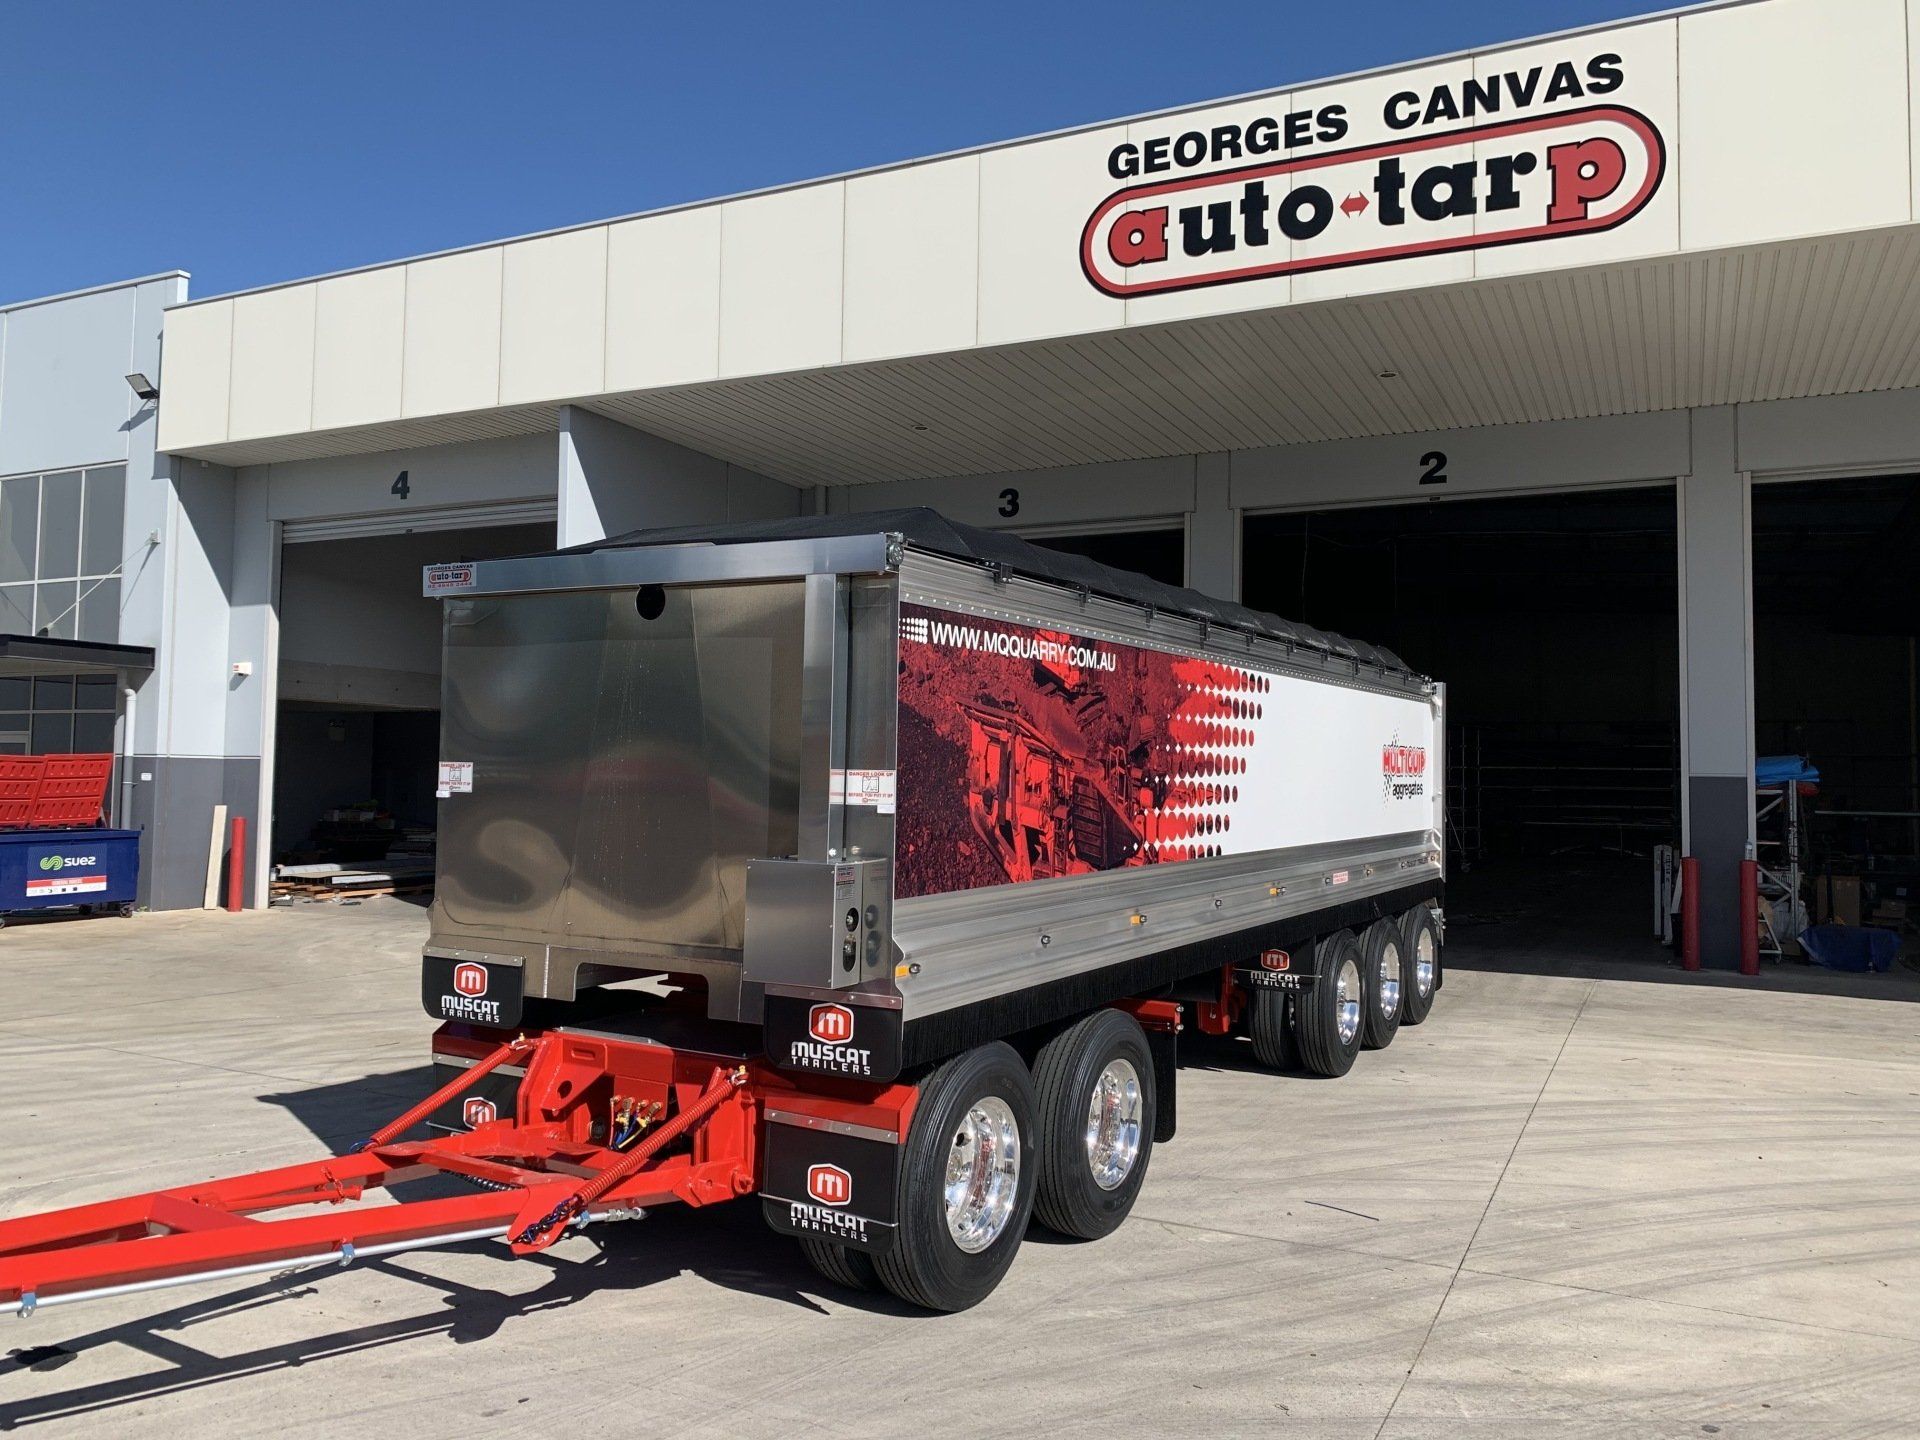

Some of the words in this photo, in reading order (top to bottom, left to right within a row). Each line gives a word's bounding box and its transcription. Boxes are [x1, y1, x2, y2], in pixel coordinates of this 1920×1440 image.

[1107, 104, 1349, 179] GEORGES
[1383, 52, 1625, 130] CANVAS
[1419, 450, 1448, 485] 2
[391, 470, 410, 500] 4
[998, 487, 1020, 518] 3
[930, 621, 1116, 672] WWW.MQQUARRY.COM.AU
[1392, 780, 1424, 799] aggregates
[1250, 971, 1300, 983] MUSCAT
[1250, 979, 1300, 989] TRAILERS
[441, 995, 500, 1015] MUSCAT
[441, 1007, 500, 1023] TRAILERS
[791, 1041, 871, 1066] MUSCAT
[791, 1056, 871, 1076] TRAILERS
[790, 1203, 868, 1233] MUSCAT
[790, 1217, 868, 1243] TRAILERS
